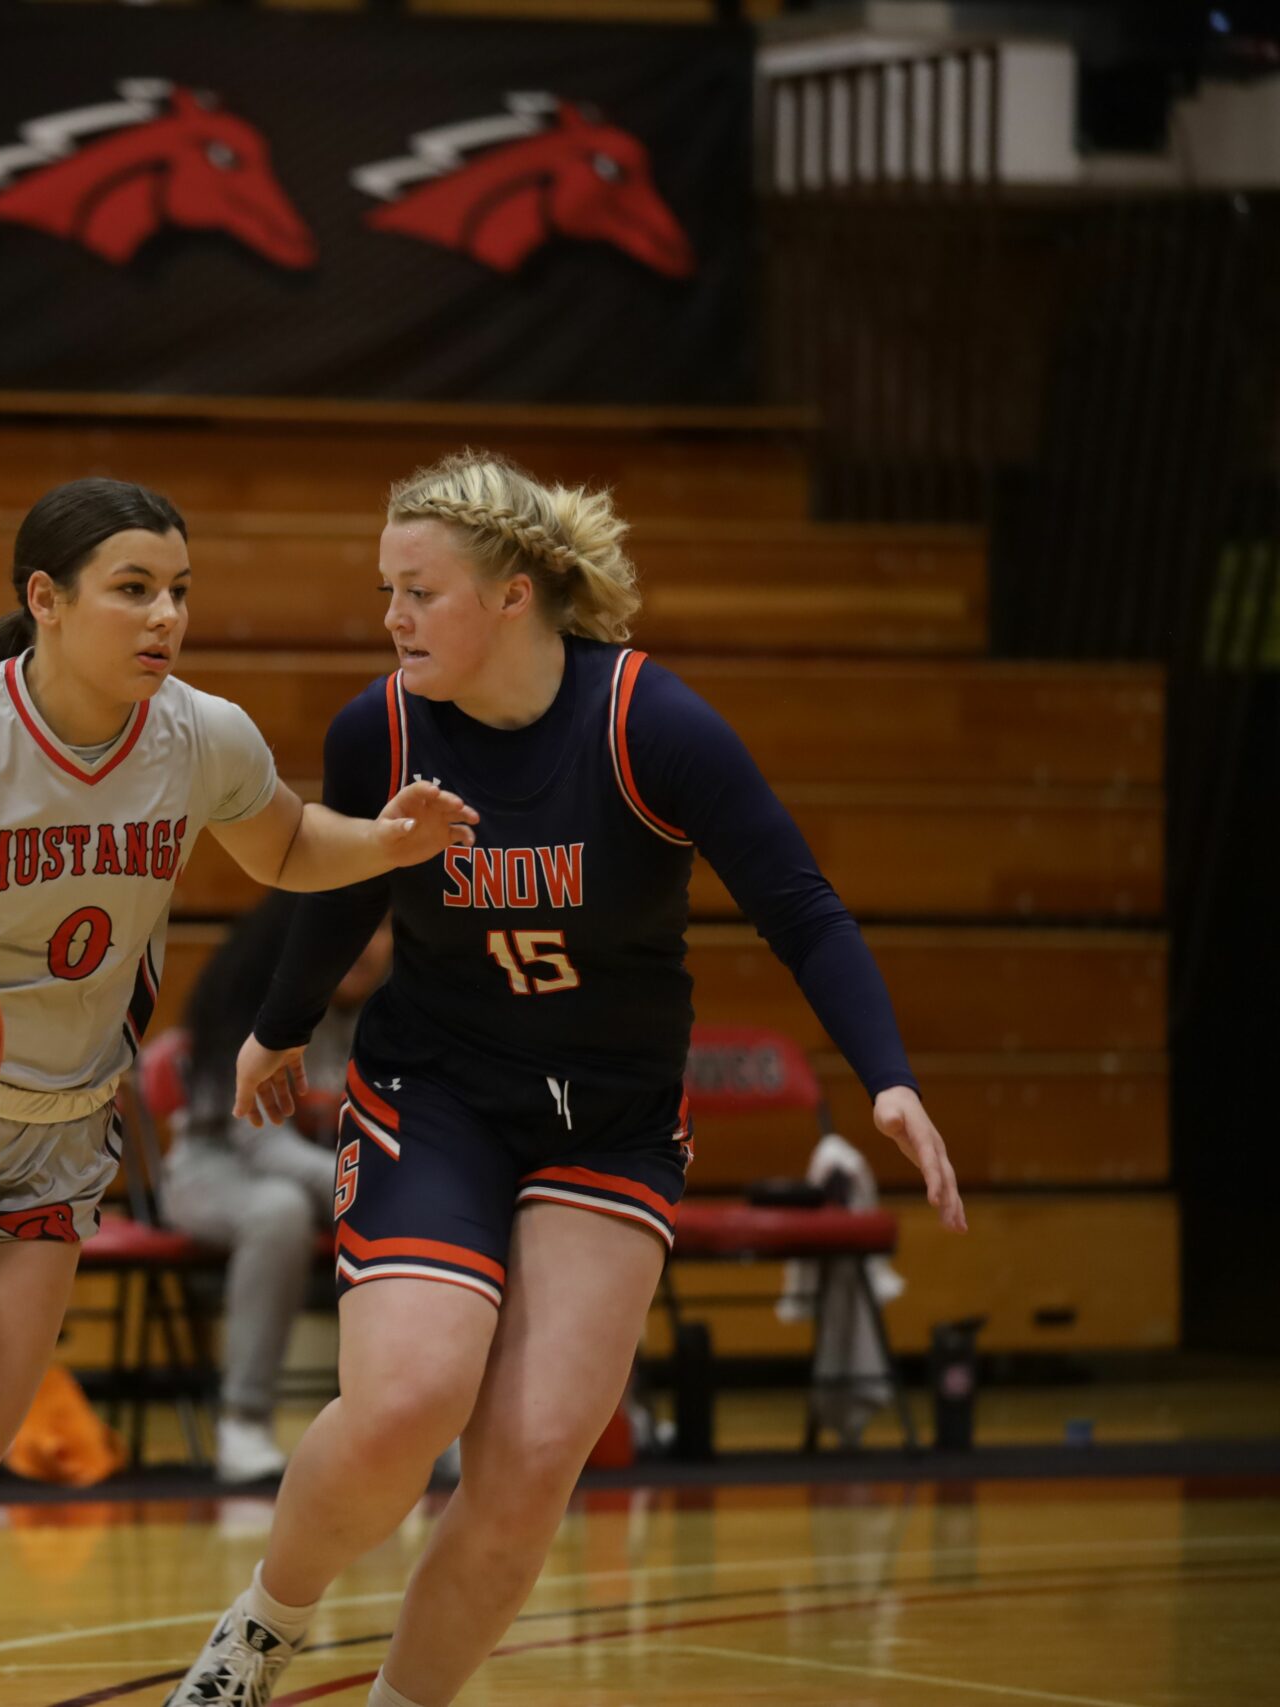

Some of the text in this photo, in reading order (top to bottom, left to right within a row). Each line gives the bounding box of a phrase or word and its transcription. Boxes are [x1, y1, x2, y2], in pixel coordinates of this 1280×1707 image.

[443, 842, 584, 909] SNOW
[46, 905, 114, 981] 0
[487, 930, 581, 995] 15
